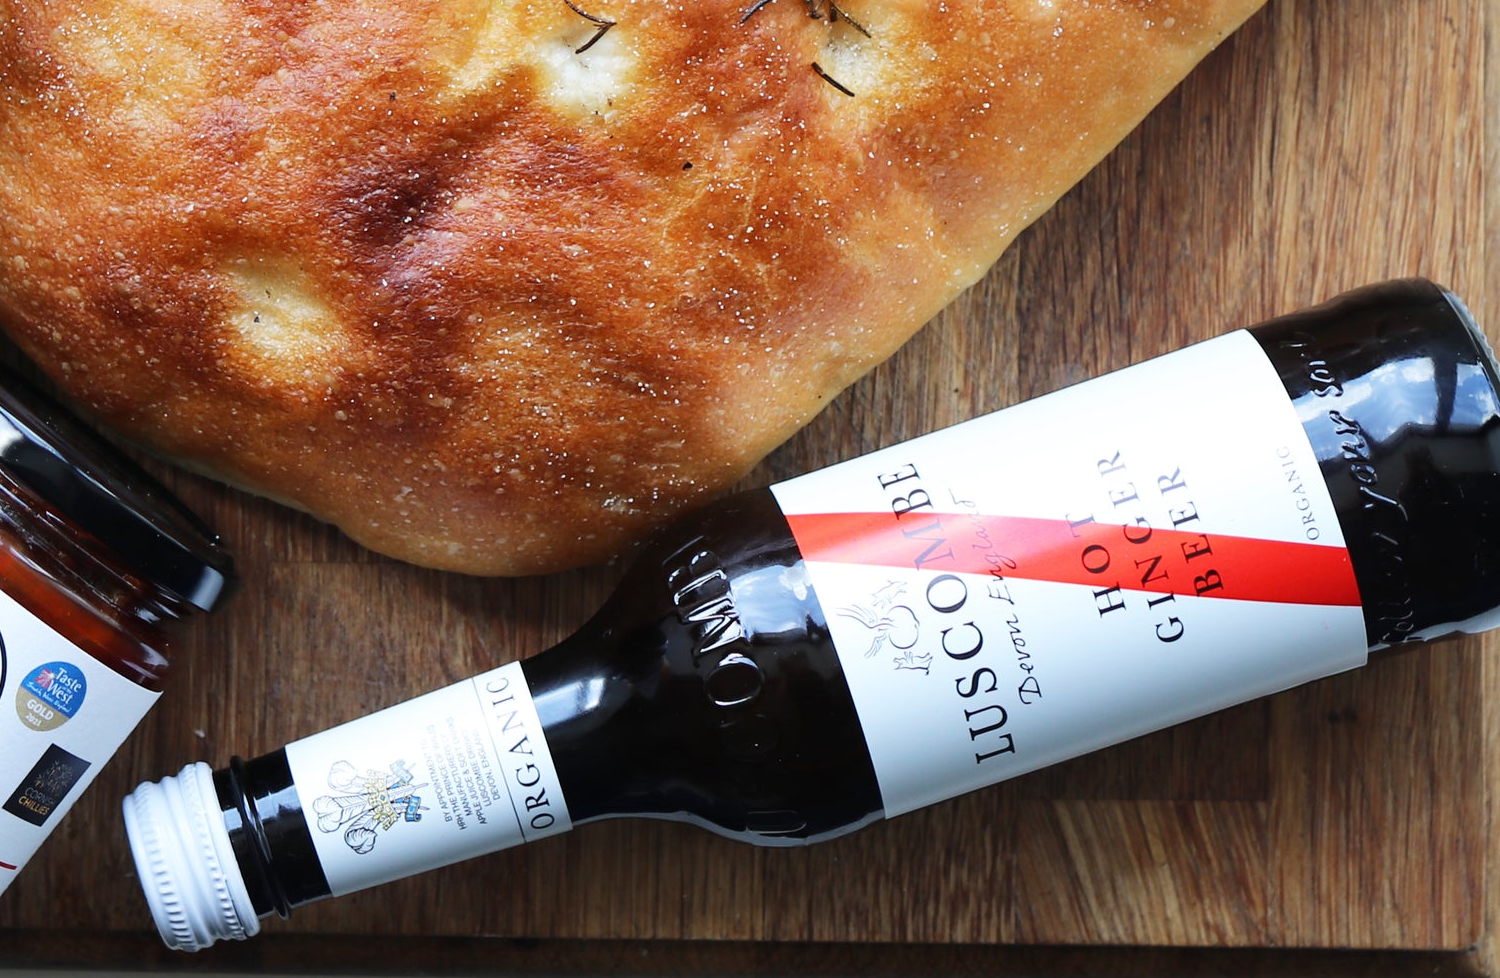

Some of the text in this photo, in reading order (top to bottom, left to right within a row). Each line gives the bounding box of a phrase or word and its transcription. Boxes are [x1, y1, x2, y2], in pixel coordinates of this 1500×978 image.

[1276, 445, 1320, 541] ORGANIC
[1097, 450, 1184, 643] GINGER
[1157, 466, 1224, 597] BEER
[1066, 512, 1126, 618] HOT
[949, 487, 1041, 705] Devon England
[876, 462, 1015, 764] LUSCOMBE
[47, 680, 73, 705] West
[56, 667, 82, 692] Taste
[26, 699, 54, 720] GOLD
[454, 745, 468, 769] SOFT
[485, 676, 554, 830] ORGANIC
[438, 764, 453, 796] PRINCE
[464, 776, 478, 800] JUICE
[470, 760, 492, 807] LUSCOMBE
[443, 812, 453, 822] BY
[449, 796, 460, 813] THE
[473, 801, 487, 824] APPLE
